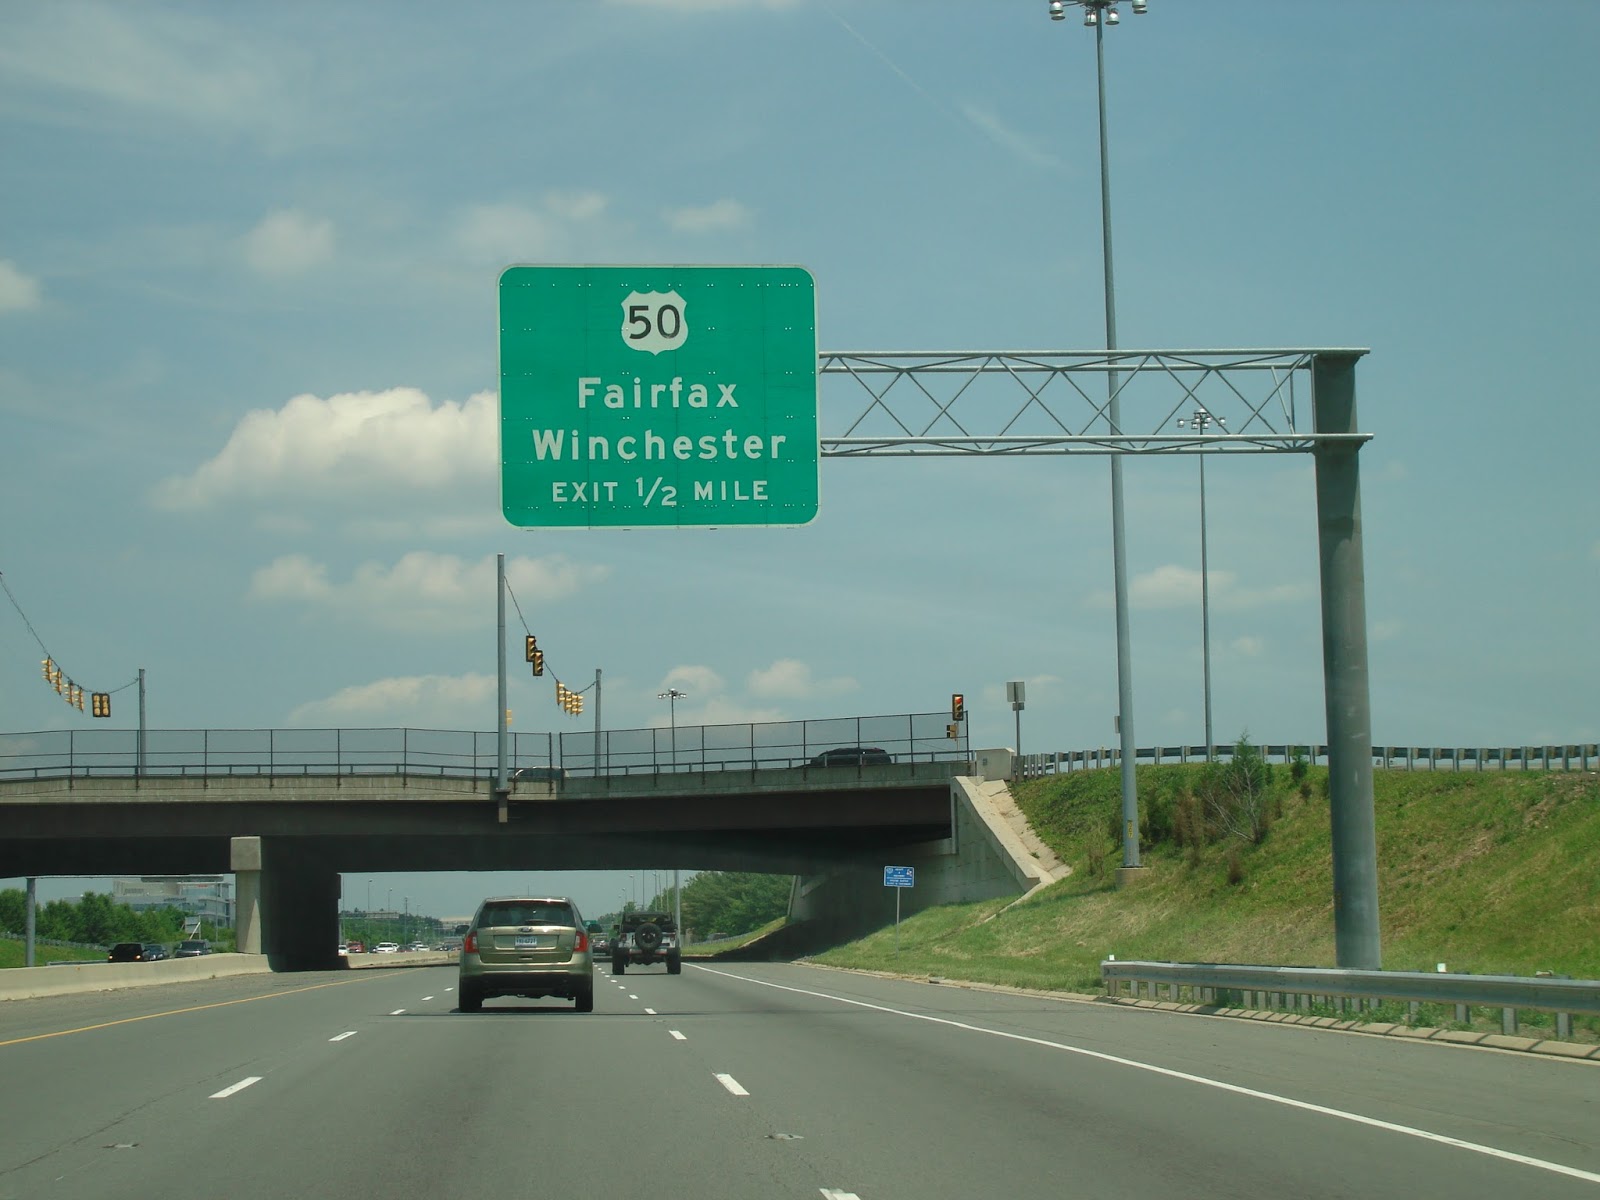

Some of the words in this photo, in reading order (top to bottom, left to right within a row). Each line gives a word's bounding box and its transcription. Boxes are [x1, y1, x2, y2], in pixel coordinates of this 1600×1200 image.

[629, 304, 680, 339] 50
[578, 377, 738, 408] Fairfax
[532, 429, 786, 460] Winchester
[552, 481, 619, 502] EXIT
[635, 477, 677, 507] 1/2
[694, 480, 768, 501] MILE
